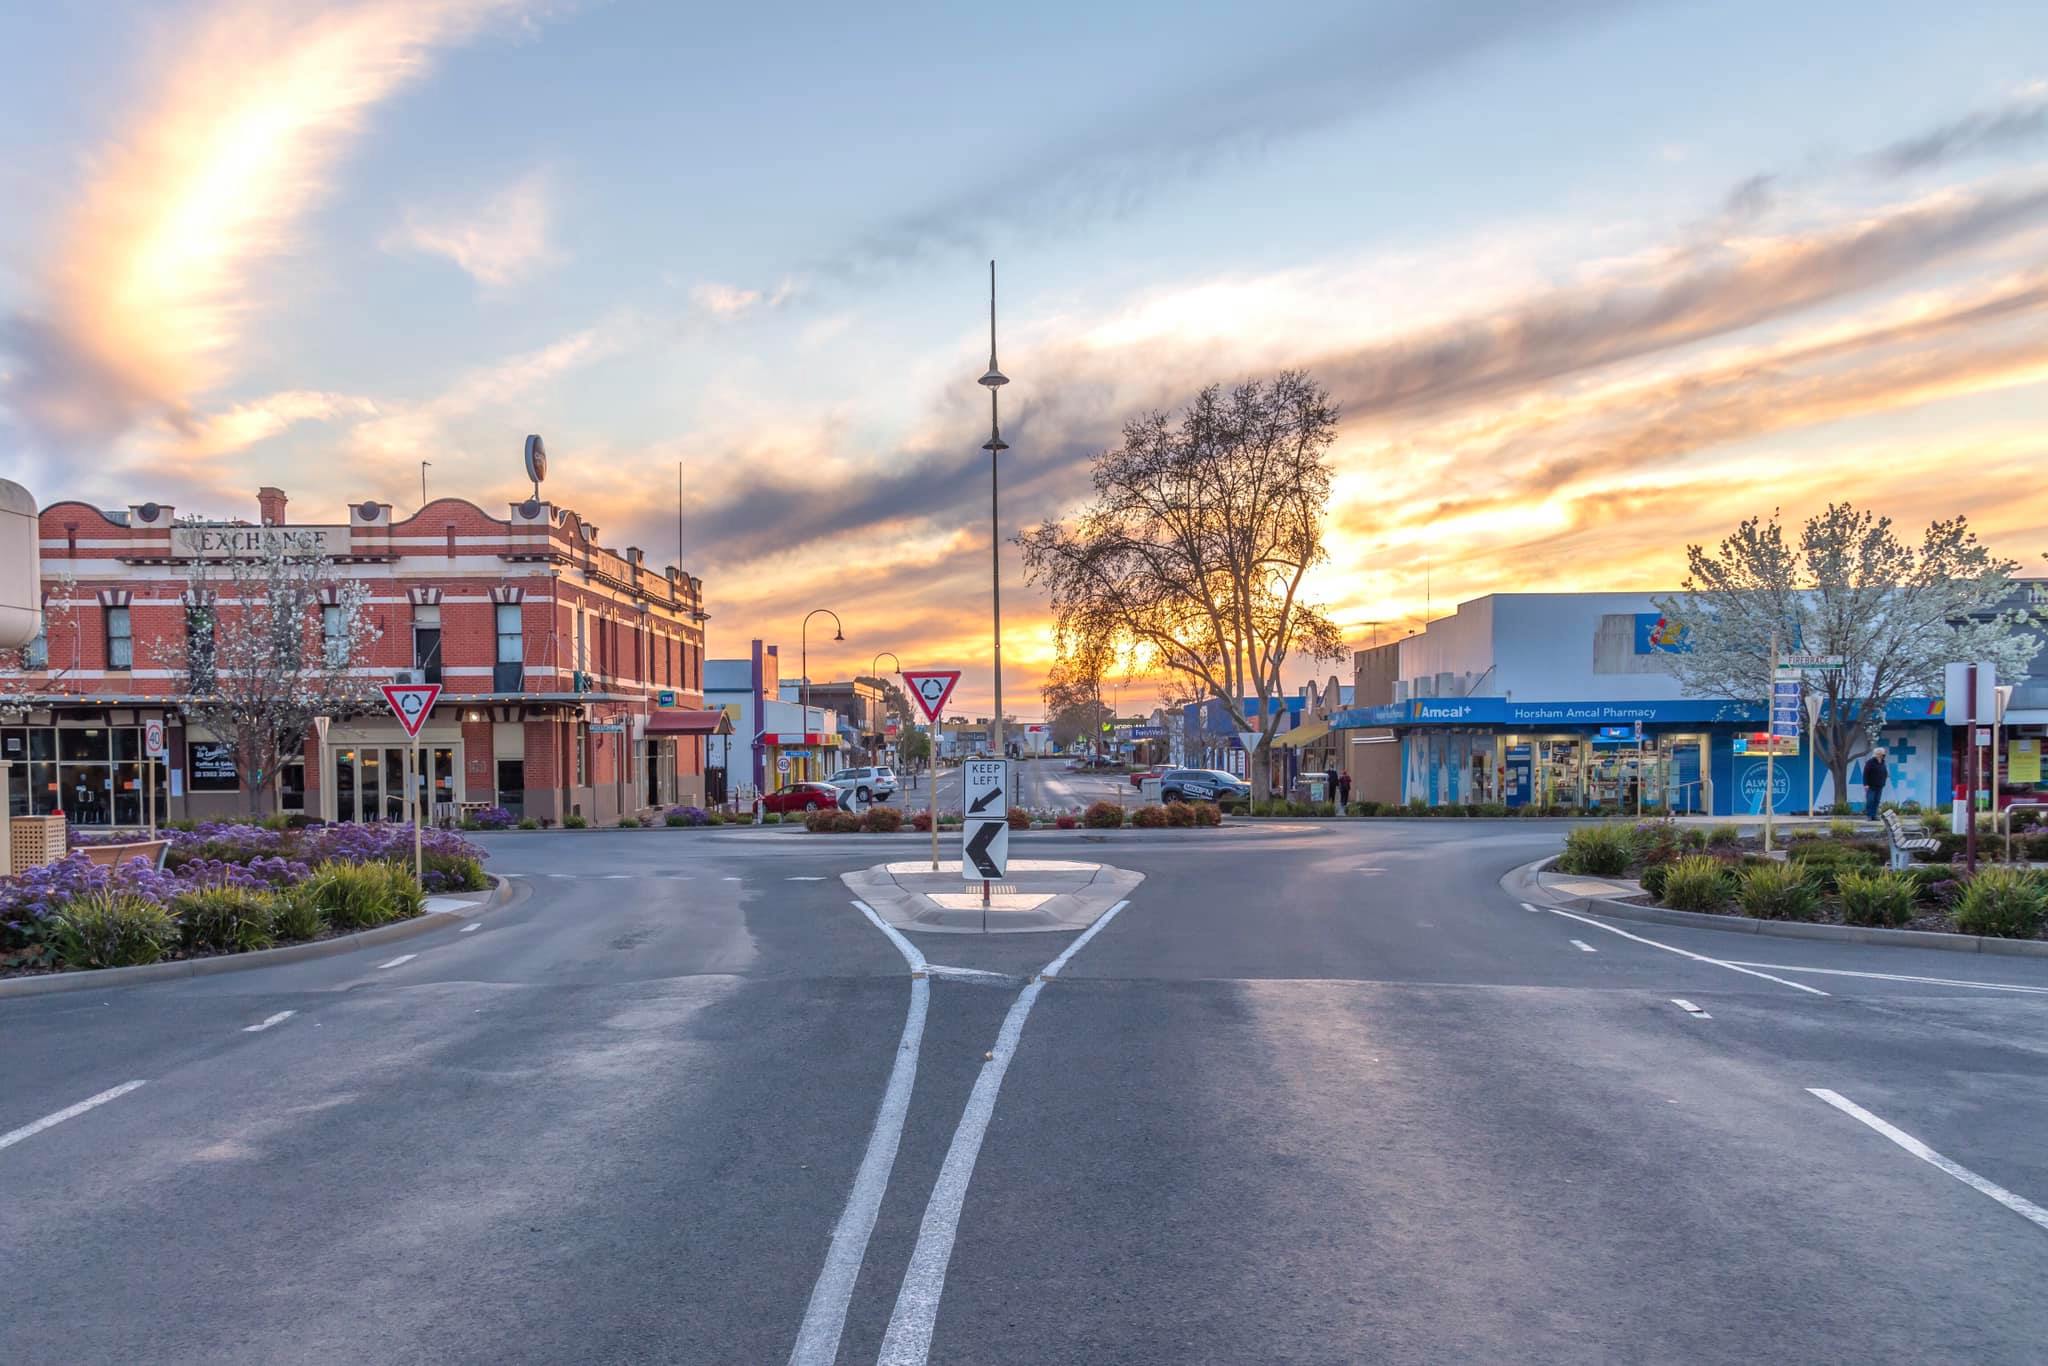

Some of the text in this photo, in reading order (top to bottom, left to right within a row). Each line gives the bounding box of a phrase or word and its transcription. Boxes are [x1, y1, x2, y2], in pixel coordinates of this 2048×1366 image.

[202, 531, 327, 550] EXCHANGE
[1788, 655, 1829, 664] FIREBRACE
[1514, 707, 1657, 719] Horsham Amcal Pharmacy
[149, 731, 161, 745] 40
[972, 764, 1000, 773] KEEP
[973, 776, 999, 785] LEFT
[1745, 779, 1786, 787] ALWYS
